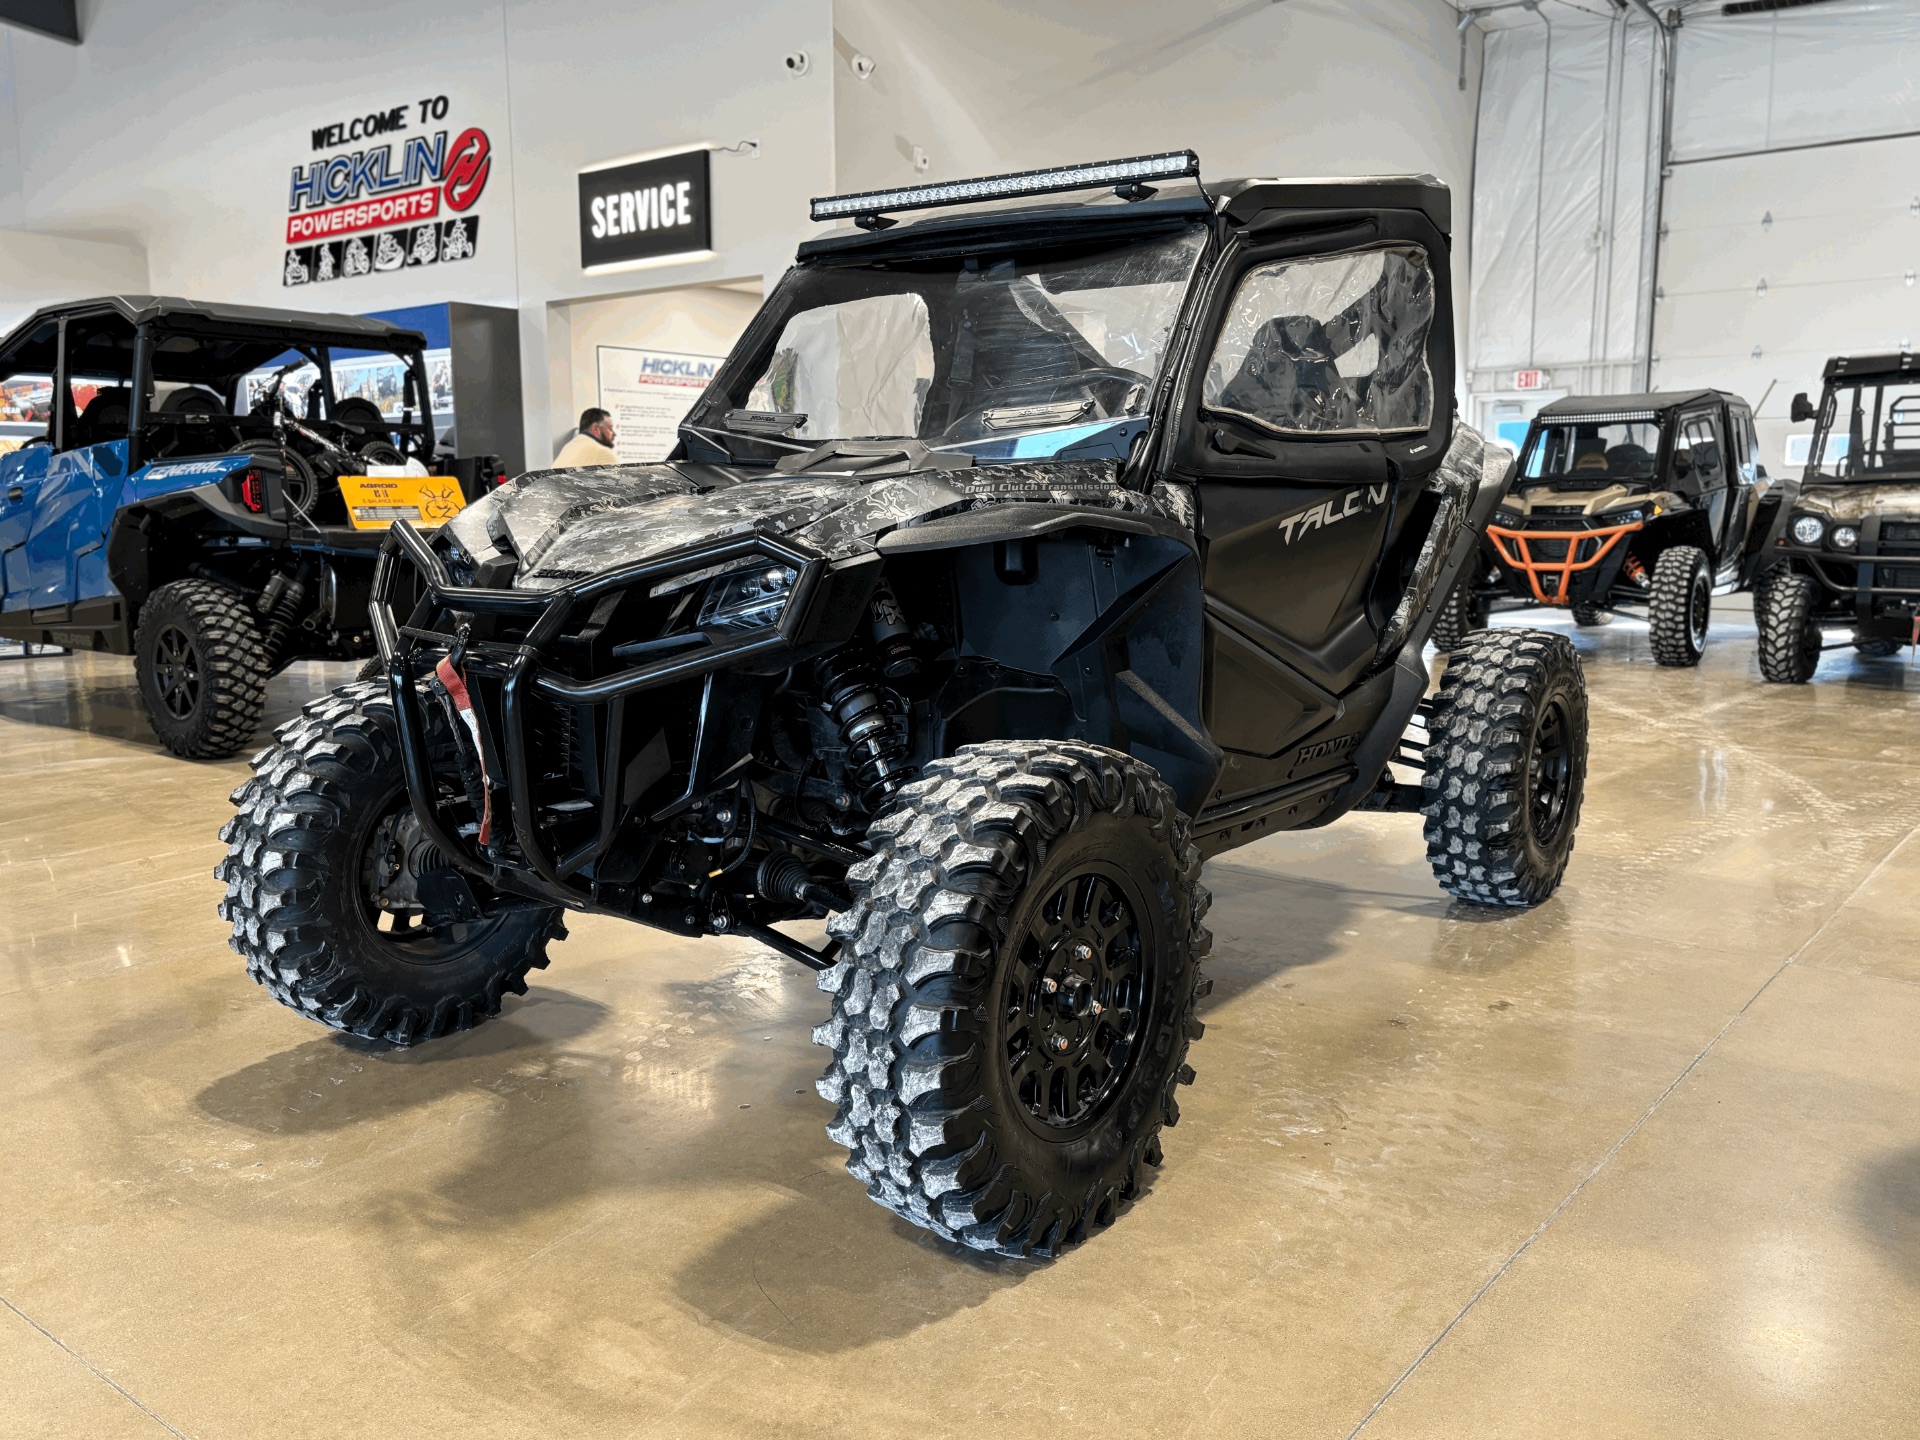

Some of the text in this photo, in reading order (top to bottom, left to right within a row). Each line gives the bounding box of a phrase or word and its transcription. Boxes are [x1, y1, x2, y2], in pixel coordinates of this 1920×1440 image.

[311, 95, 449, 151] WELCOME TO
[289, 131, 447, 212] HICKLIN
[289, 192, 434, 239] POWERSPORTS
[591, 181, 691, 239] SERVICE
[641, 357, 715, 378] HICKLIN
[1517, 370, 1538, 388] EXIT
[143, 460, 227, 481] GENERAL
[964, 482, 1117, 494] Dual Clutch Transmission
[1278, 481, 1389, 546] TALON
[1294, 730, 1361, 767] HONDA
